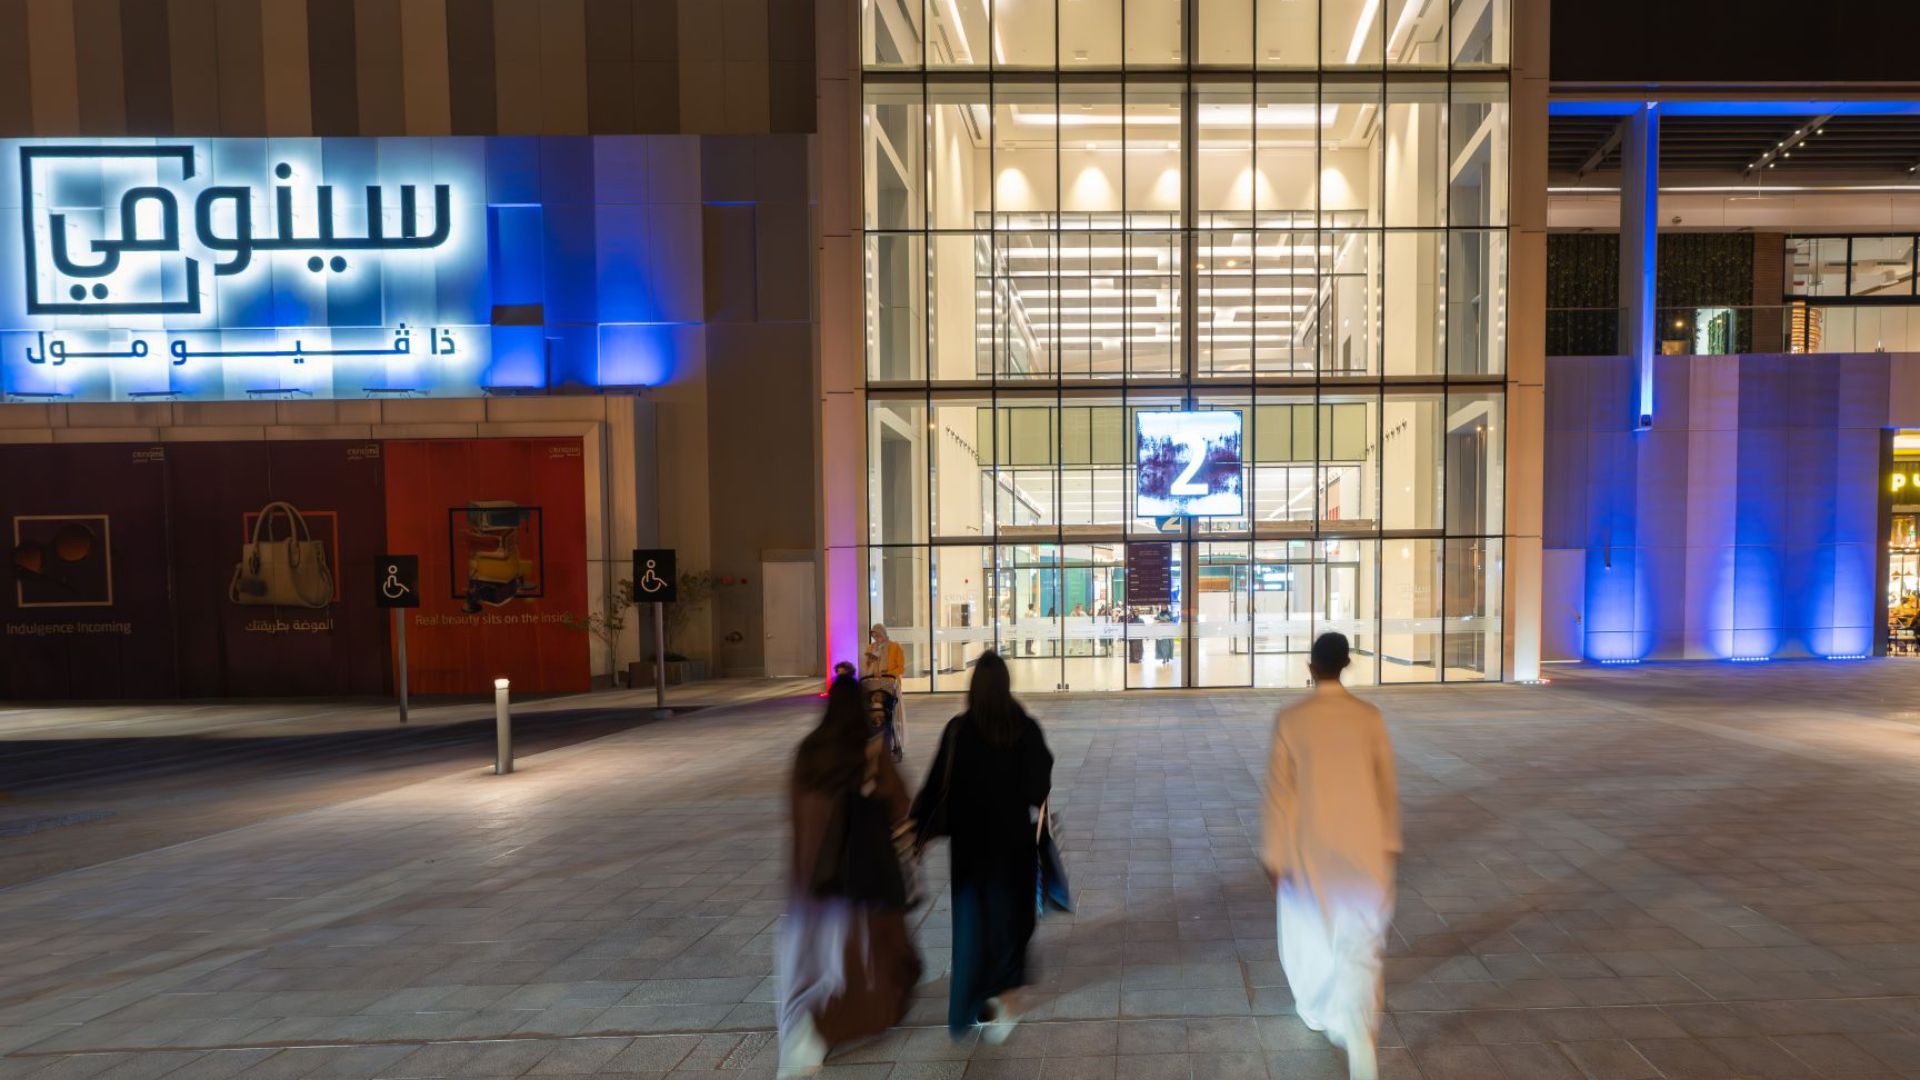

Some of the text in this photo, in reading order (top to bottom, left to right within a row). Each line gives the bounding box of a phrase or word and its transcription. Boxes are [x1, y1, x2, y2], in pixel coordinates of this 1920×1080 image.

[48, 162, 450, 301] سينومي
[430, 329, 456, 355] ذا
[1171, 434, 1208, 495] 2
[6, 621, 132, 636] Indulgence Incoming
[293, 618, 334, 633] الموضة
[415, 614, 439, 625] Real
[442, 613, 480, 627] beauty
[482, 613, 503, 625] sits
[504, 615, 519, 624] on
[521, 613, 539, 624] the
